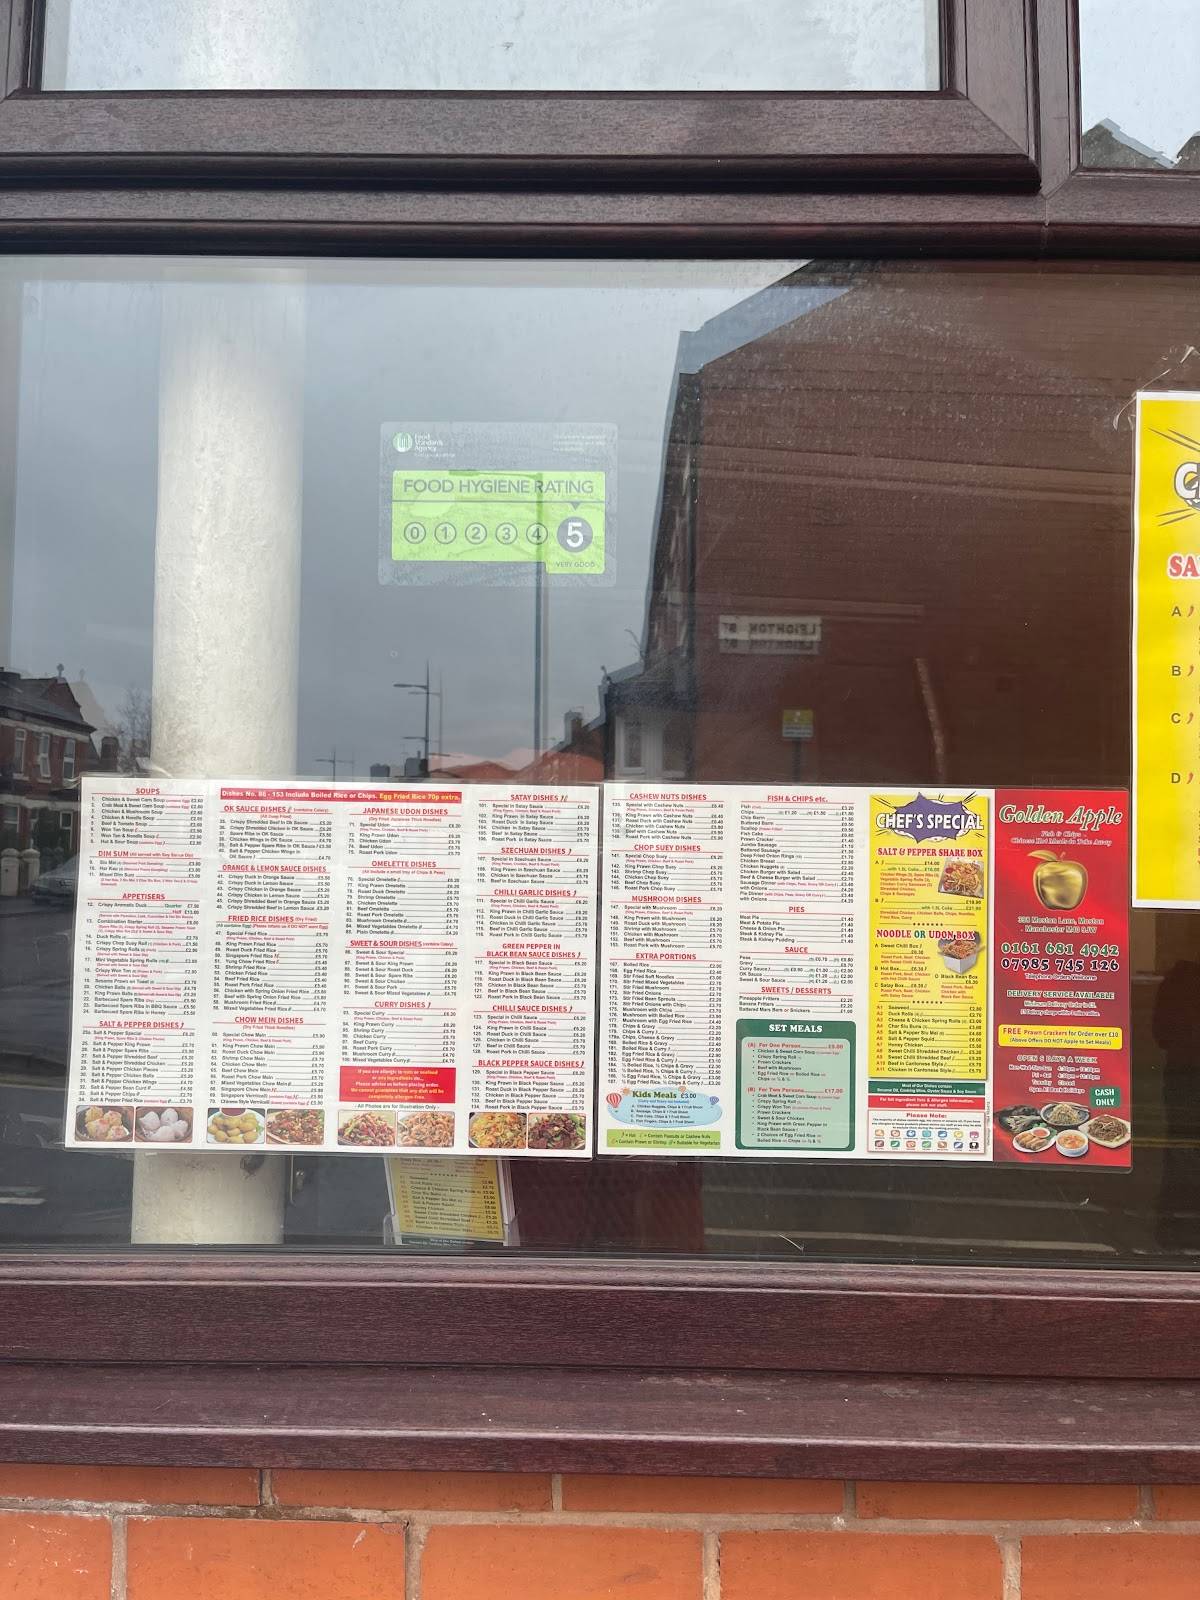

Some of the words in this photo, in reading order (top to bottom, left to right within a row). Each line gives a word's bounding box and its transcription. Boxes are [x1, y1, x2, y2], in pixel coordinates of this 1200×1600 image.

[404, 480, 454, 492] FOOD
[460, 480, 529, 493] HYGIENE
[535, 481, 593, 493] RATING
[1175, 462, 1200, 499] C
[410, 527, 419, 539] 0
[441, 528, 448, 539] 1
[472, 528, 480, 539] 2
[502, 528, 511, 540] 3
[532, 528, 541, 540] 4
[566, 522, 584, 547] 5
[1169, 556, 1200, 576] SA
[1172, 607, 1181, 616] A
[1172, 666, 1181, 676] B
[1171, 713, 1180, 724] C
[1171, 774, 1180, 783] D
[876, 813, 924, 829] CHEF'S
[927, 814, 984, 829] SPECIAL
[999, 805, 1064, 824] Golden
[1066, 806, 1122, 831] Apple
[914, 930, 926, 938] OR
[929, 931, 954, 939] UDON
[956, 931, 975, 939] BOX
[1001, 943, 1039, 954] 0161
[1046, 943, 1074, 955] 681
[1080, 944, 1119, 957] 4942
[1001, 958, 1049, 971] 07985
[1055, 959, 1084, 971] 745
[1091, 960, 1119, 971] 126
[1075, 991, 1114, 999] AVAILABLE
